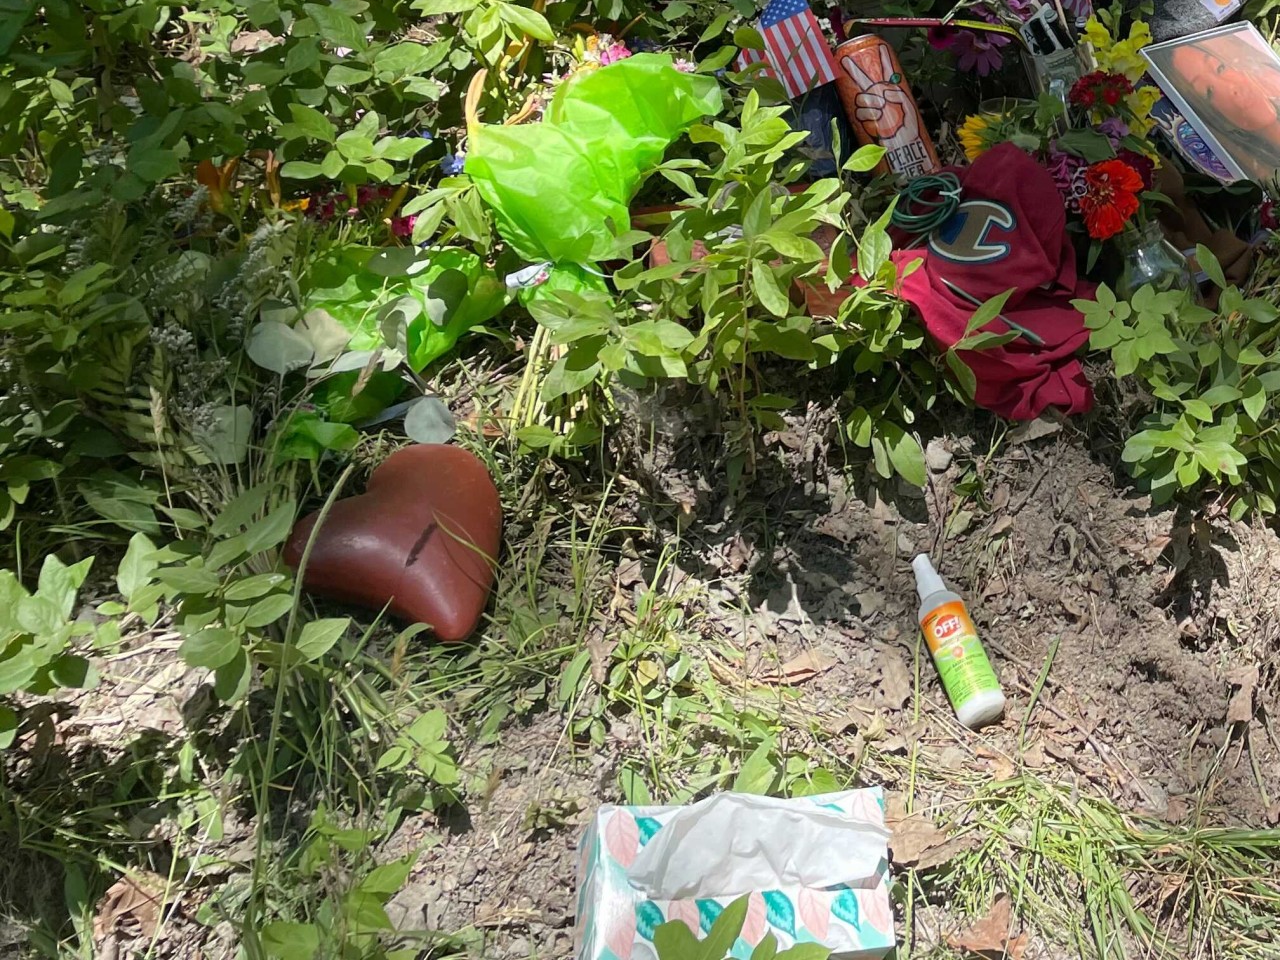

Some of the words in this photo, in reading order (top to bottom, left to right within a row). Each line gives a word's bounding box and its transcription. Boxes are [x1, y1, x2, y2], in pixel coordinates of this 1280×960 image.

[1024, 29, 1034, 43] A
[887, 141, 927, 170] PEACE
[934, 615, 961, 638] OFF!
